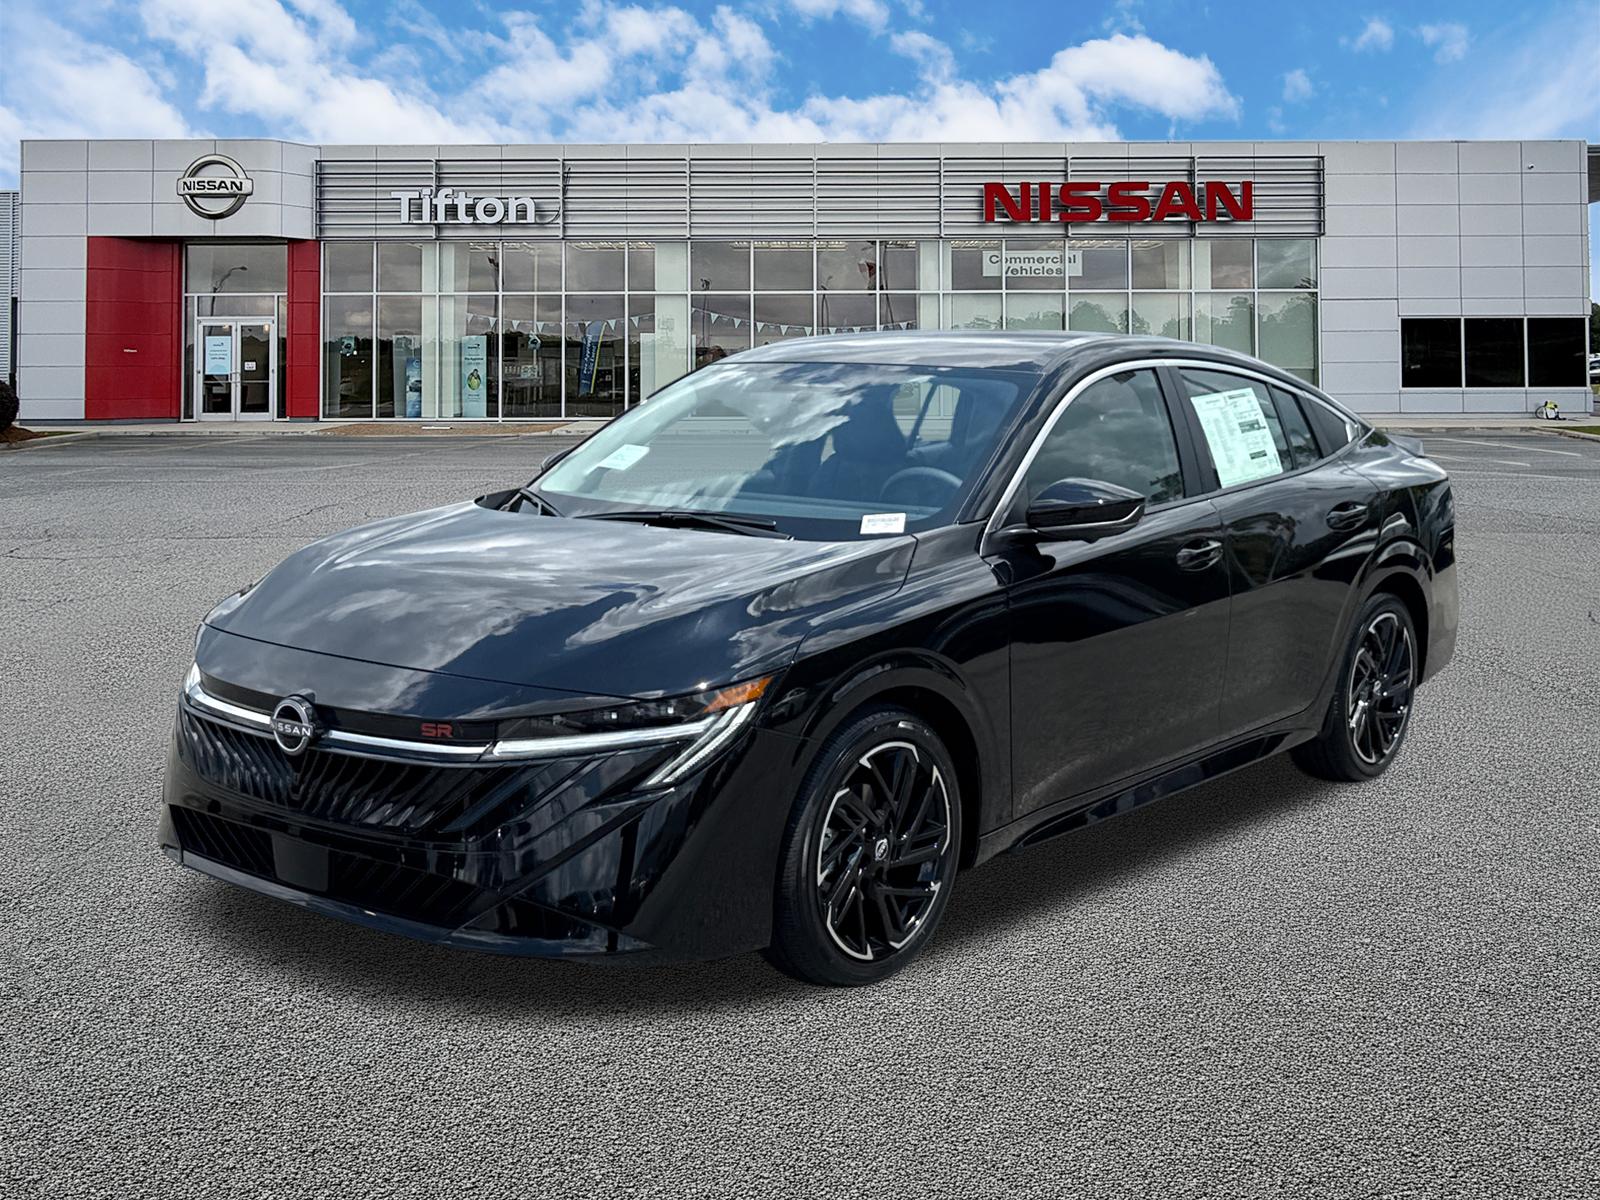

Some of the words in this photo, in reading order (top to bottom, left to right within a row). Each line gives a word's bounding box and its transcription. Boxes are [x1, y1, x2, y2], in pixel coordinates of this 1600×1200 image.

[182, 180, 243, 191] NISSAN
[390, 188, 536, 224] Tifton
[983, 180, 1254, 222] NISSAN
[270, 719, 311, 736] NISSAN
[421, 722, 453, 738] SR
